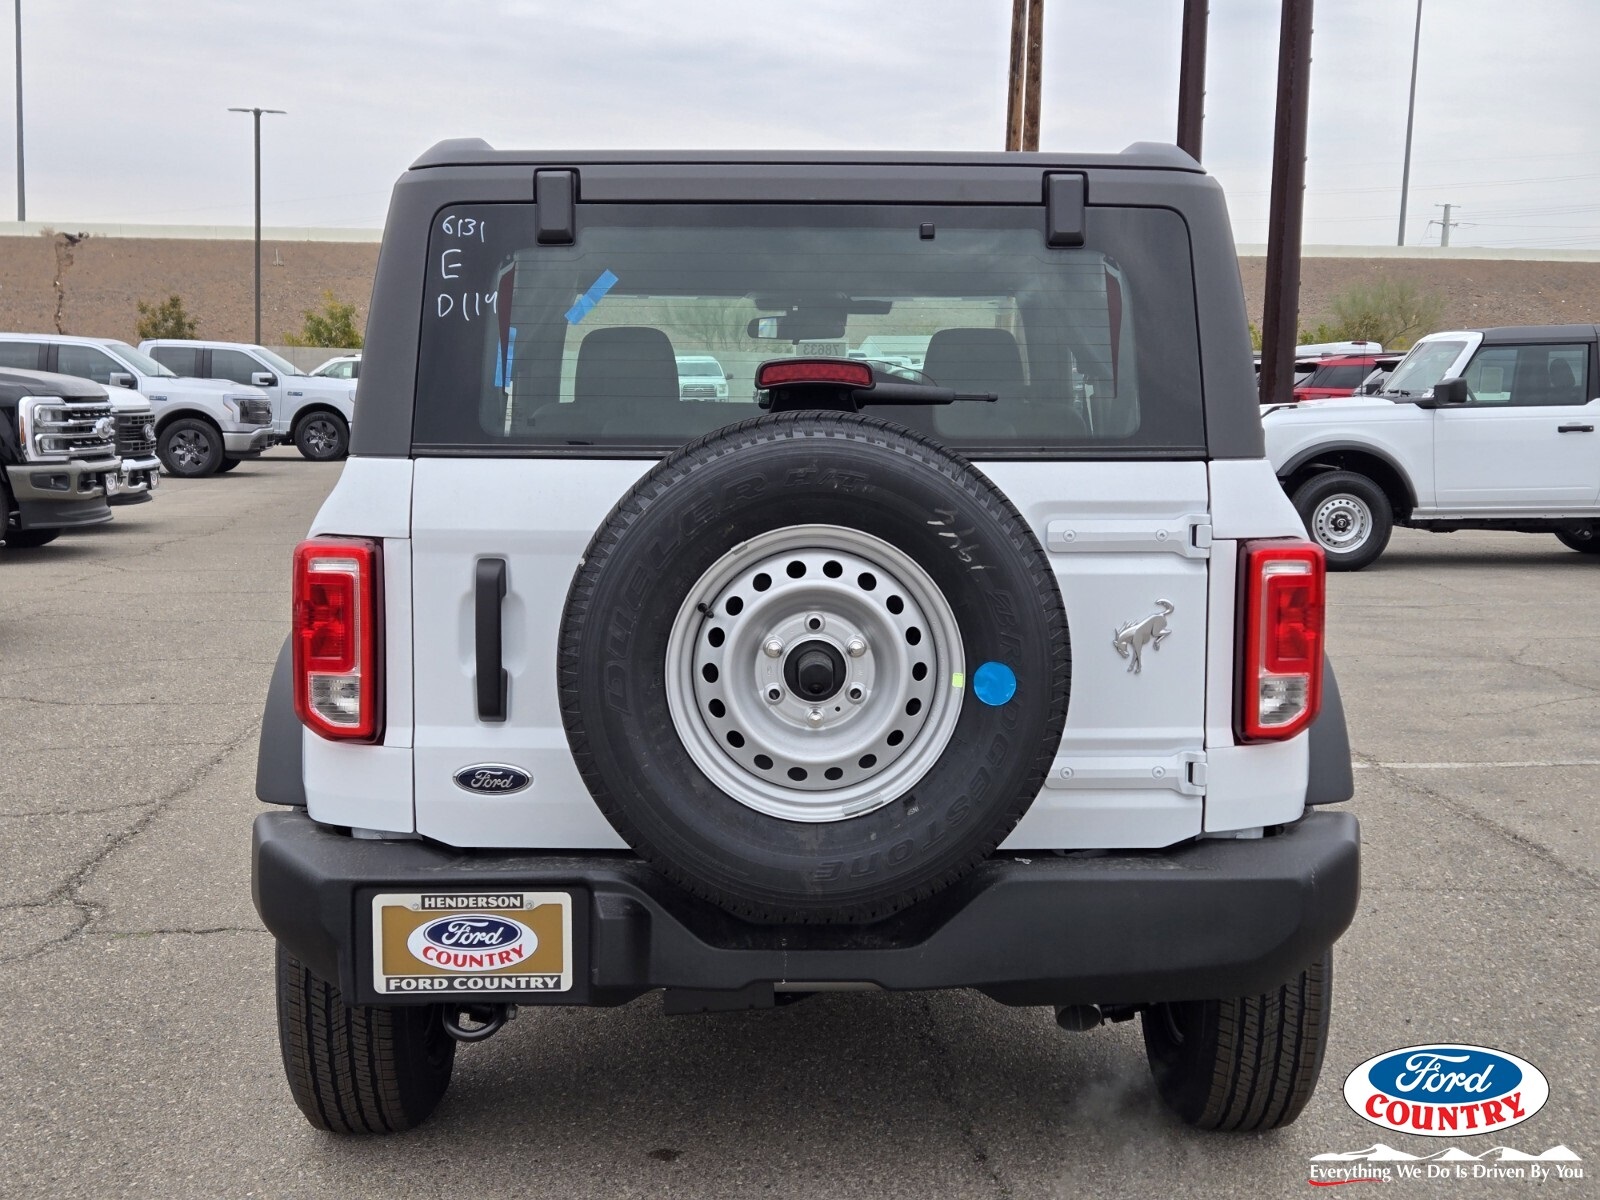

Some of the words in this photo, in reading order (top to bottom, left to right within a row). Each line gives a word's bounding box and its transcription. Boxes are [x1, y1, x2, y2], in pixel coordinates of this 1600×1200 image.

[442, 215, 485, 242] 6131
[441, 249, 462, 279] E
[471, 770, 514, 790] Ford
[423, 896, 522, 909] HENDERSON
[441, 920, 505, 945] Ford
[422, 943, 525, 968] COUNTRY
[389, 978, 449, 991] FORD
[453, 976, 559, 990] COUNTRY
